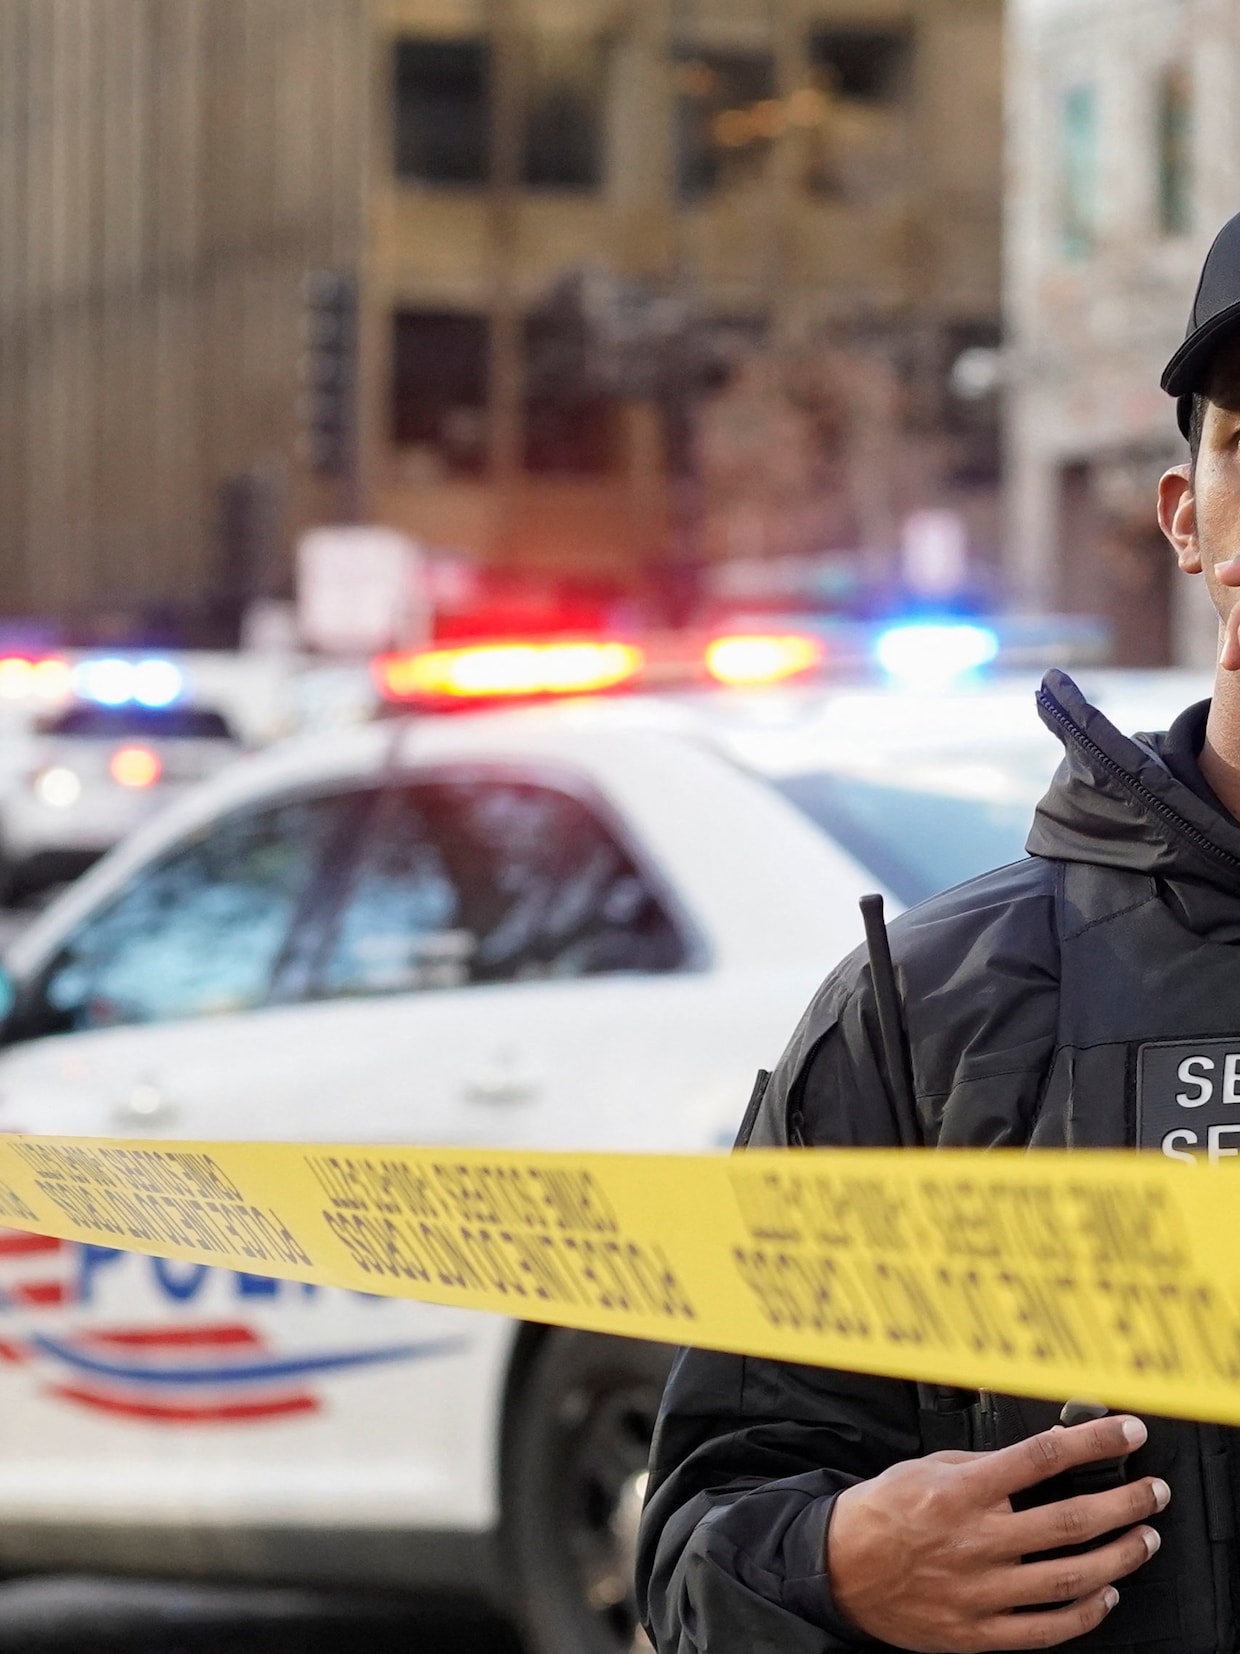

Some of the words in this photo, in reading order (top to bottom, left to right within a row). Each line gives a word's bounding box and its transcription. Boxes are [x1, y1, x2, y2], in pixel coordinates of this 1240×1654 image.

[98, 1147, 196, 1198] SOLVERS
[164, 1152, 244, 1202] CRIME
[34, 1179, 125, 1235] CROSS
[95, 1188, 167, 1243] NOT
[133, 1193, 197, 1248] DO
[160, 1197, 241, 1256] LINE
[206, 1201, 313, 1266] POLICE
[322, 1210, 431, 1282] CROSS
[405, 1220, 488, 1292] NOT
[460, 1226, 527, 1296] DO
[500, 1231, 594, 1306] LINE
[564, 1237, 698, 1321] POLICE
[730, 1245, 872, 1341] CROSS
